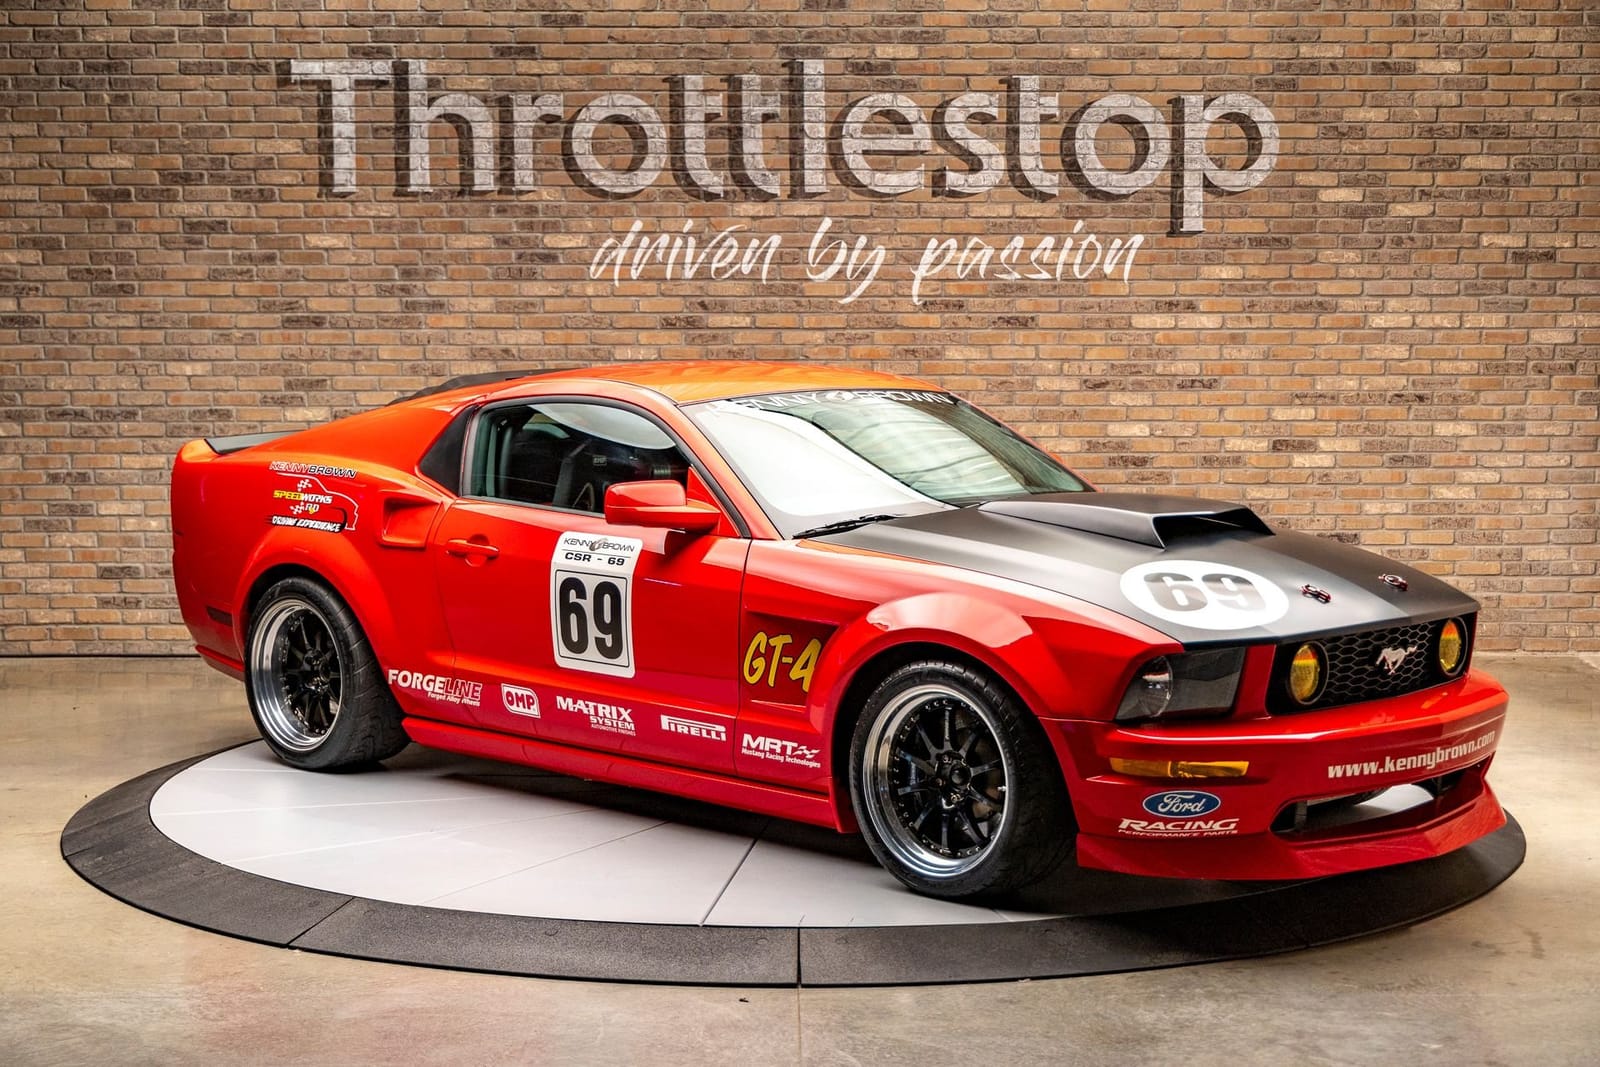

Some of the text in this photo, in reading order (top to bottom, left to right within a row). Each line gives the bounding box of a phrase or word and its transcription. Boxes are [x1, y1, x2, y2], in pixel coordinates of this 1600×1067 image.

[289, 57, 1281, 236] Throttlestop
[589, 217, 1145, 306] driven by passion
[564, 551, 592, 563] CSR
[607, 556, 626, 566] 69
[602, 541, 635, 553] BROWN
[1143, 571, 1267, 613] 69
[559, 577, 623, 660] 69
[743, 631, 822, 693] GT-4
[388, 669, 483, 701] FORGELINE
[505, 689, 536, 709] OMP
[556, 695, 633, 723] MATRIX
[589, 715, 636, 731] SYSTEM
[660, 714, 726, 741] PIRELLI
[742, 733, 798, 756] MRT
[1327, 731, 1496, 779] www.kennybrown.com
[741, 747, 821, 768] Mustang Racing Technologies
[1158, 793, 1206, 812] Ford
[1118, 818, 1240, 832] RACING
[1202, 829, 1239, 837] PARTS
